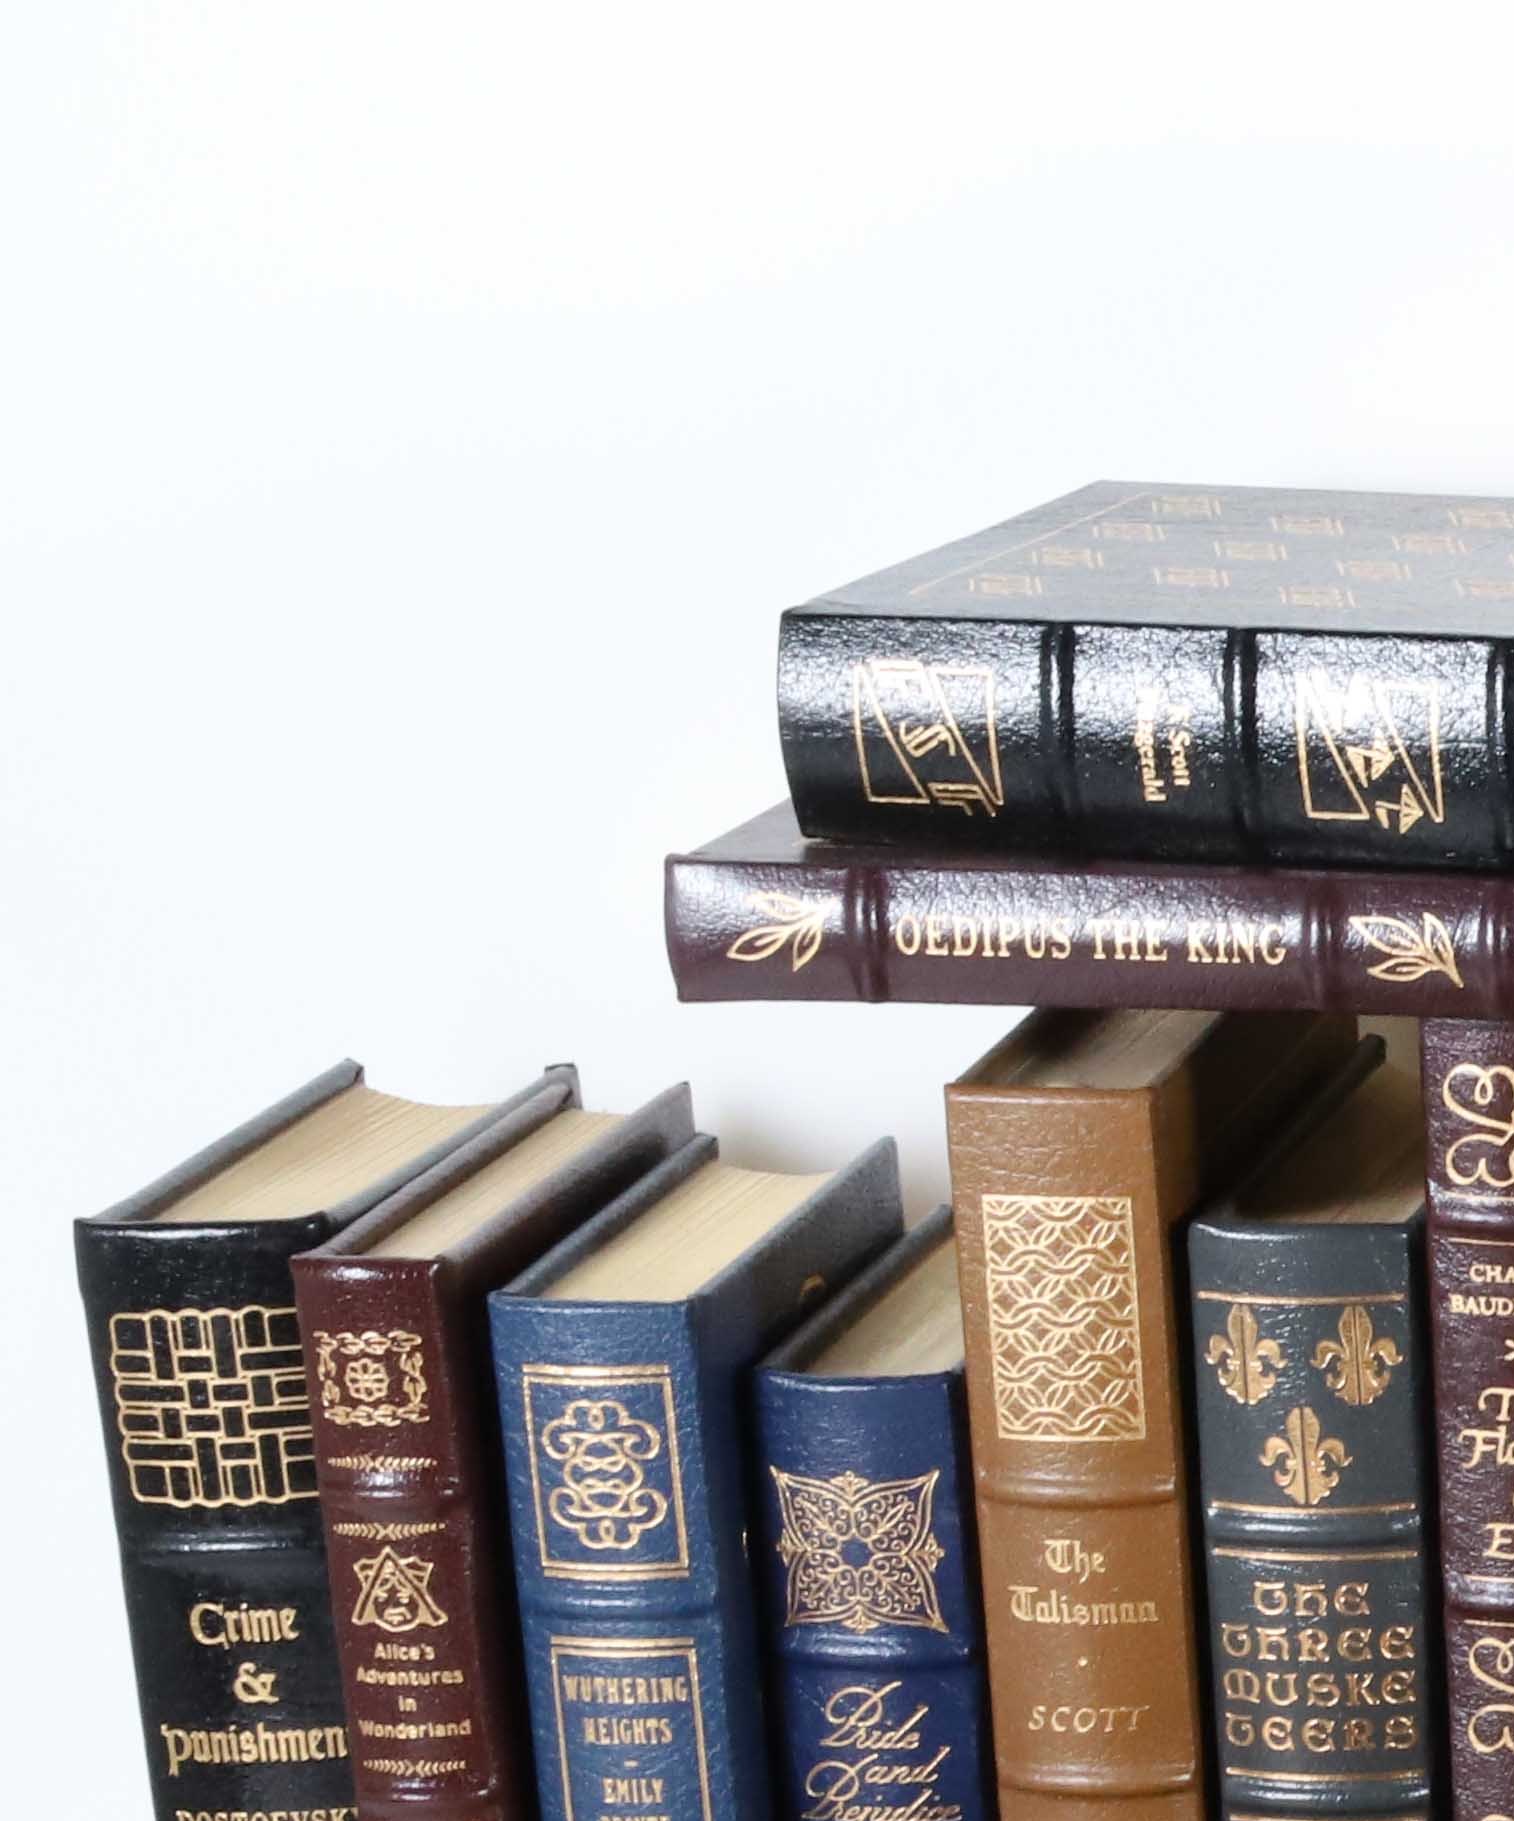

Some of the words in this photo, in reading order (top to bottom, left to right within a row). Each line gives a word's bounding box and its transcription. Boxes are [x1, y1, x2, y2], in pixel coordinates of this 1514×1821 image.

[894, 914, 1072, 960] OEDIPUS
[1186, 921, 1289, 966] KING
[1007, 1586, 1160, 1626] Talisman
[188, 1600, 301, 1650] Crime
[372, 1641, 436, 1664] Alice's
[355, 1667, 466, 1689] Adventures
[562, 1674, 689, 1706] WUTHERING
[357, 1717, 472, 1741] Wonderland
[582, 1715, 674, 1747] HEIGHTS
[818, 1680, 930, 1751] Pride
[1027, 1704, 1150, 1734] SCOTT
[160, 1720, 350, 1777] Punishmen
[601, 1776, 666, 1805] EMILY
